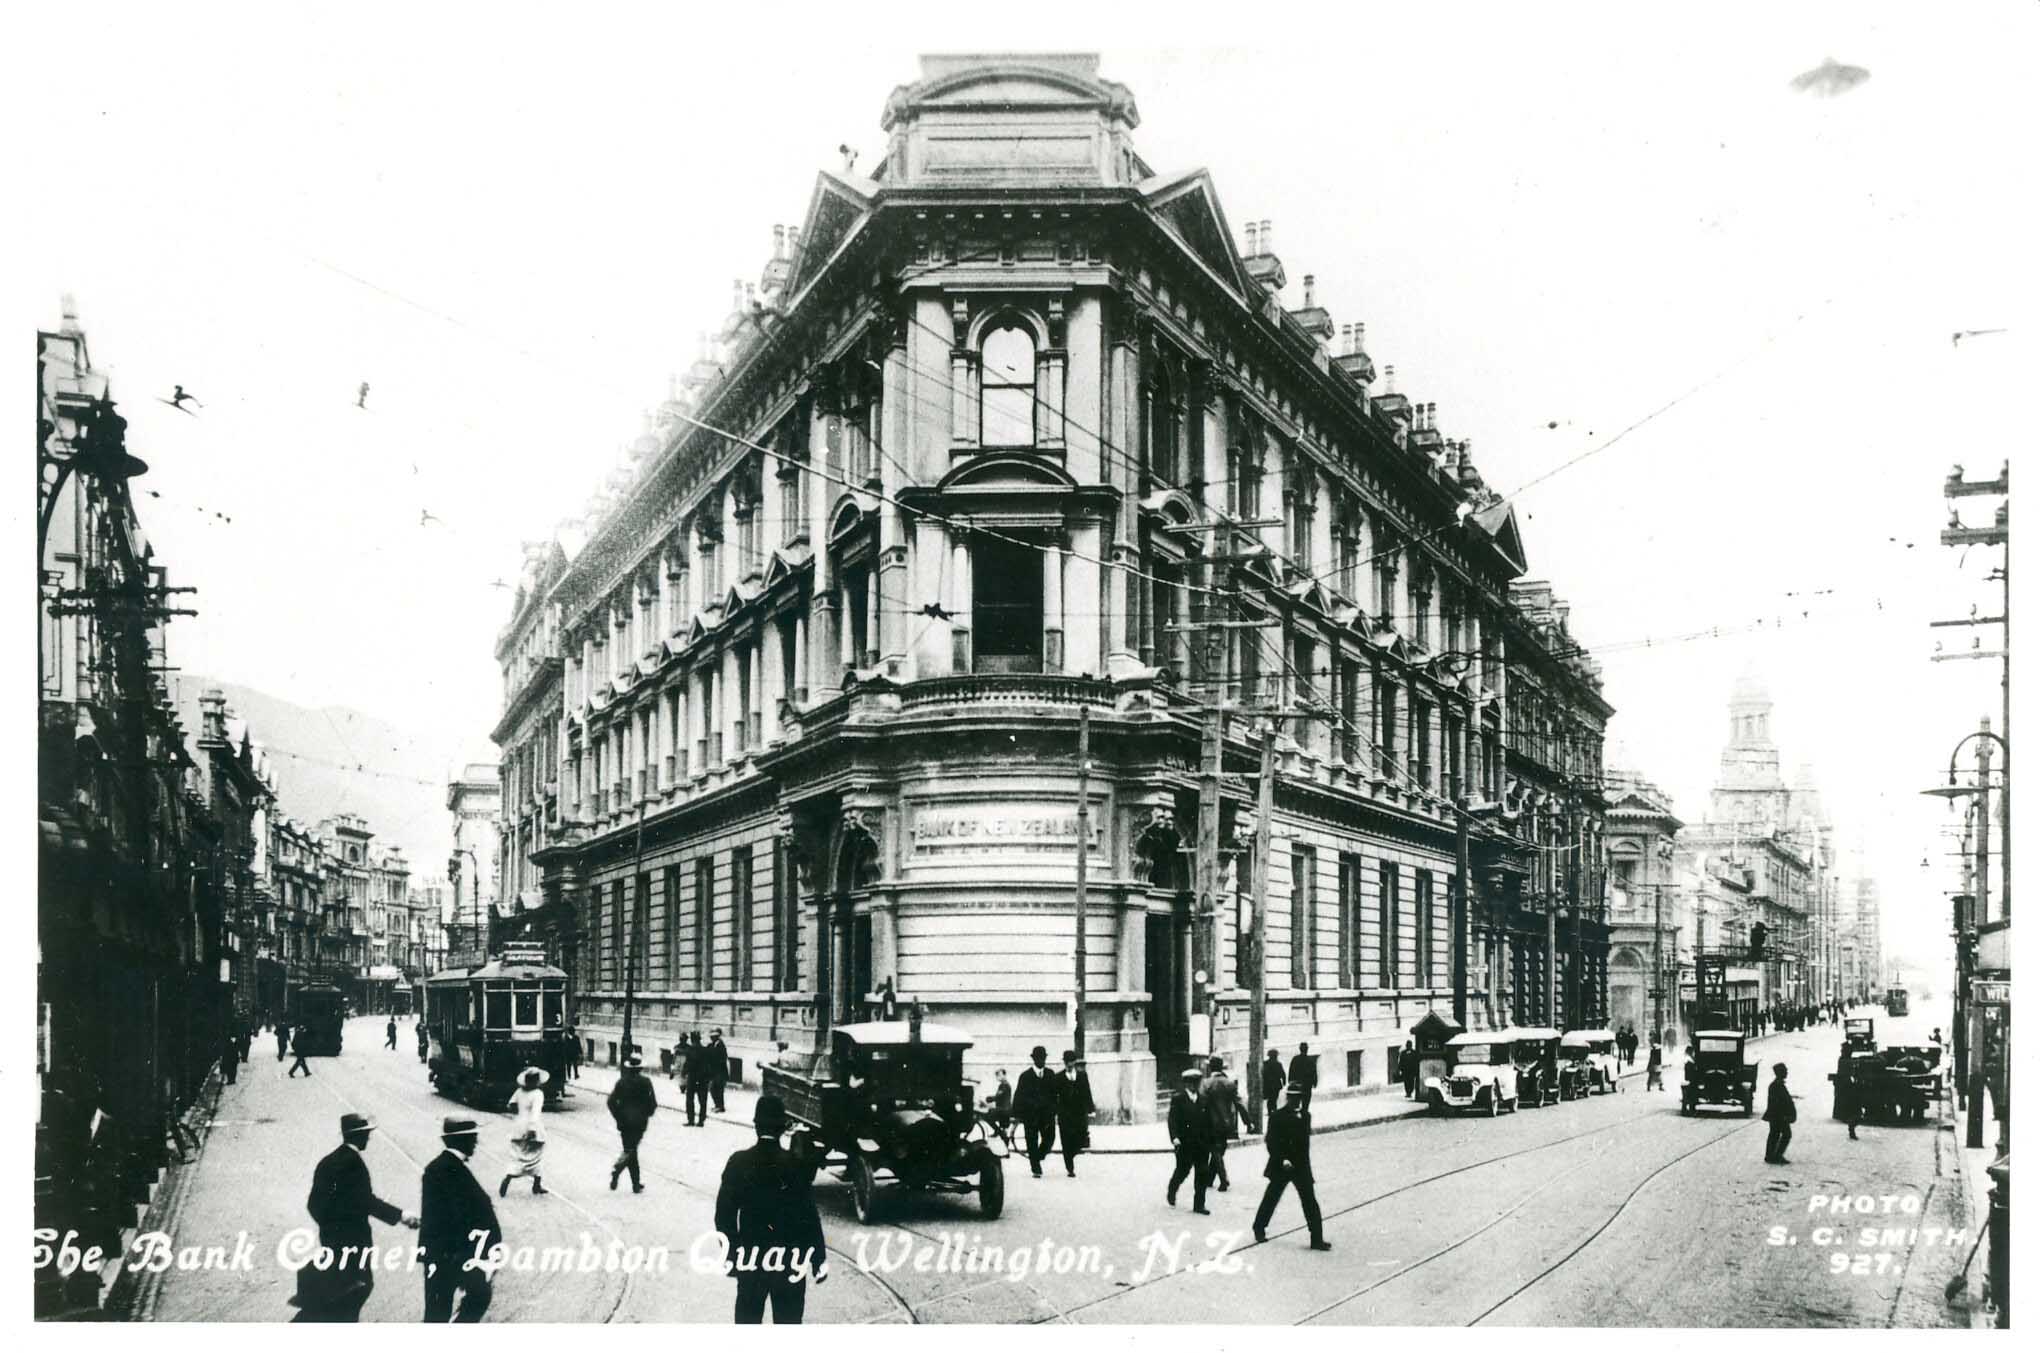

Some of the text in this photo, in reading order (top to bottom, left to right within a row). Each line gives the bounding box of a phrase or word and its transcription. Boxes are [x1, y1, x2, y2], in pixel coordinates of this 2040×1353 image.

[916, 818, 955, 840] BANK
[957, 818, 979, 838] OF
[555, 1013, 562, 1025] 3
